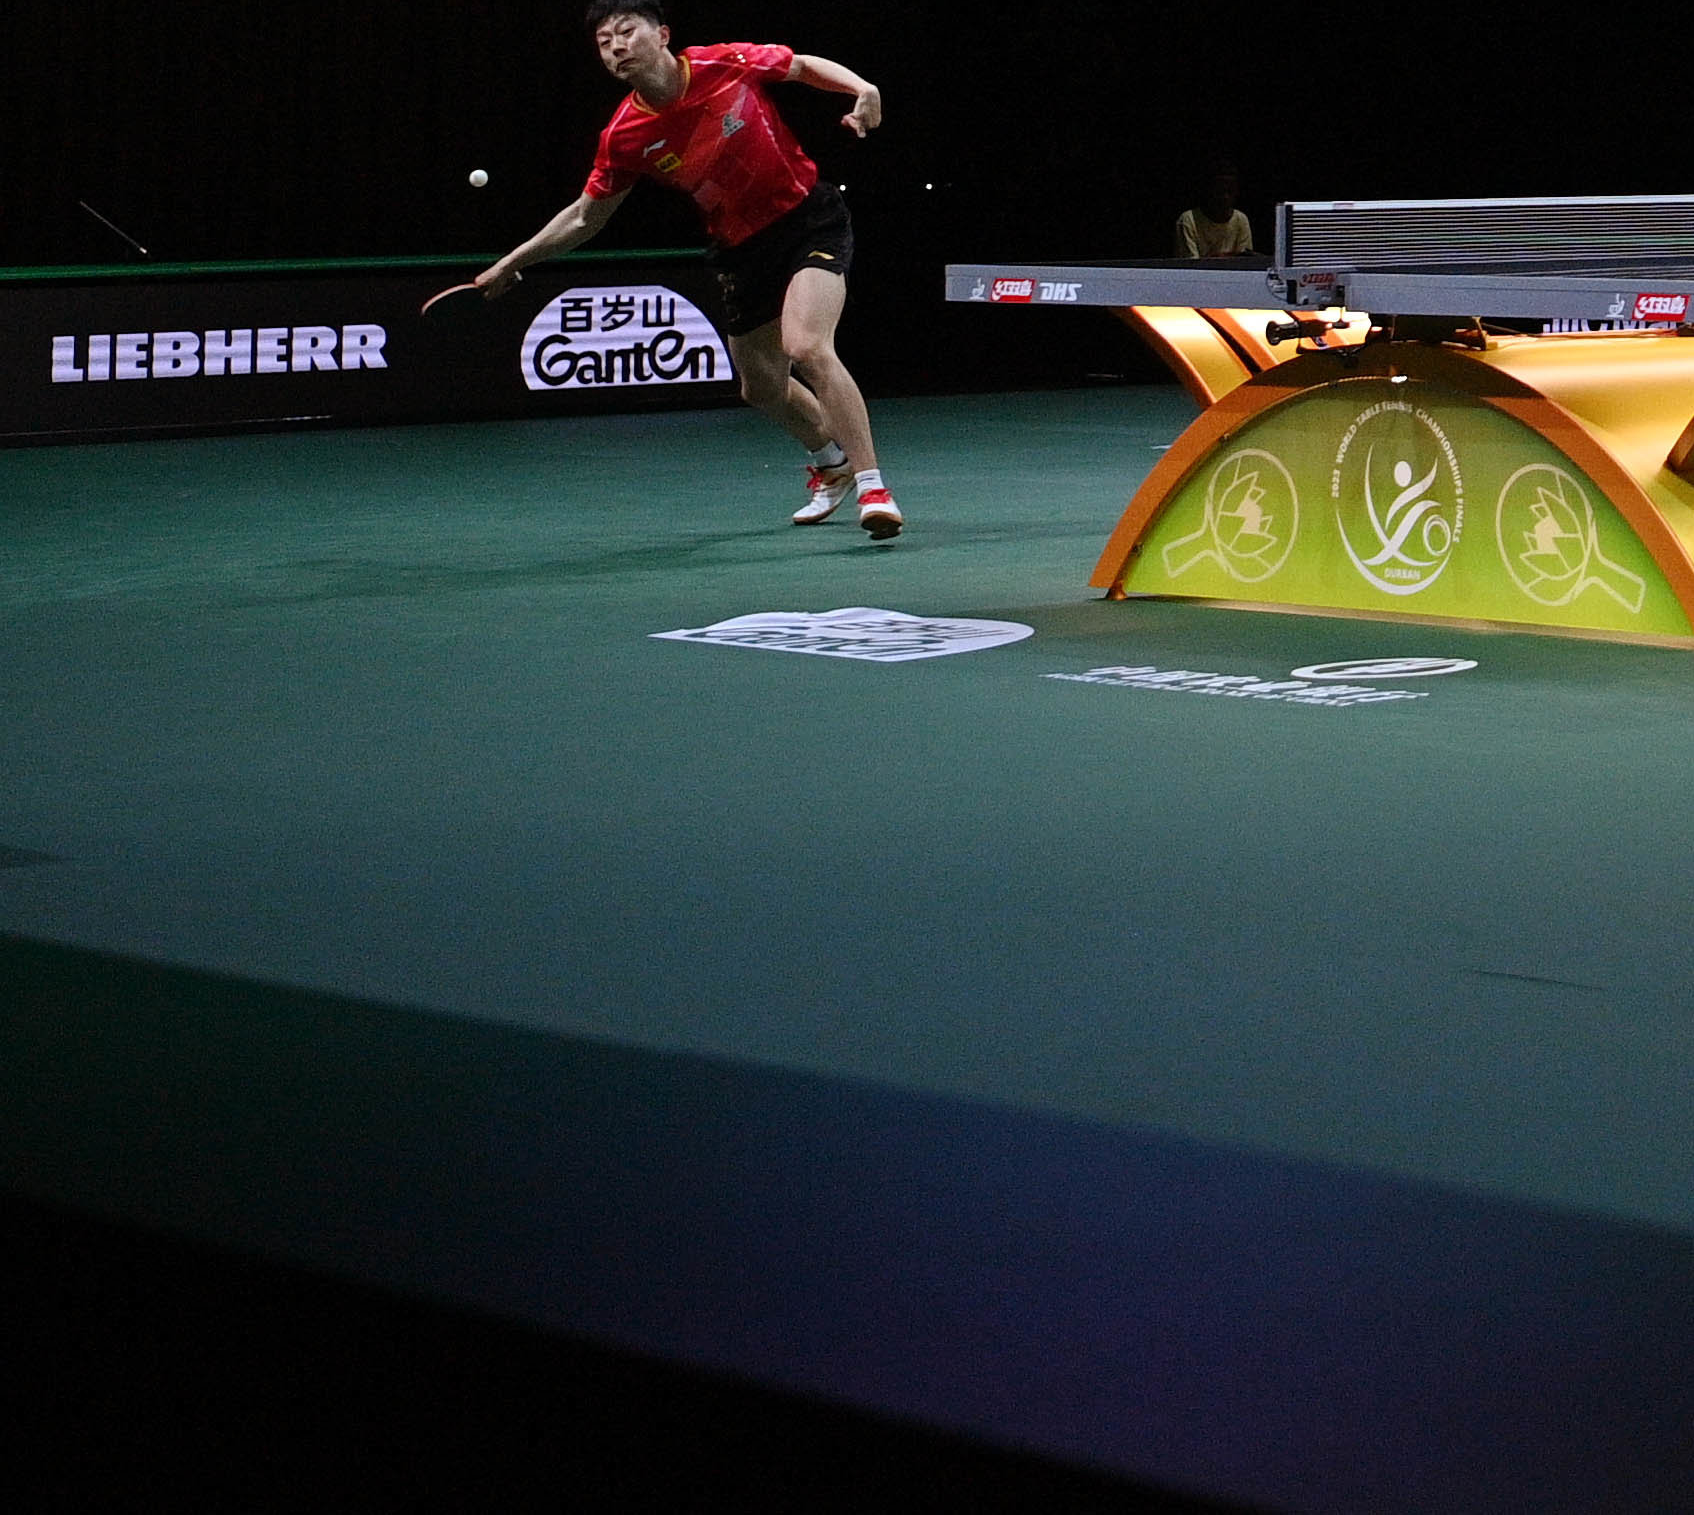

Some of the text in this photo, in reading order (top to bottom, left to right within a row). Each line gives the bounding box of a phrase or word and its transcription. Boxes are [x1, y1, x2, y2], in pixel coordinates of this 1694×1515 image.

[560, 294, 675, 333] 百岁山
[1039, 282, 1082, 301] DHS
[51, 324, 388, 383] LIEBHERR
[533, 329, 715, 385] Ganten
[1336, 425, 1357, 464] WORLD
[1356, 403, 1380, 425] TABLE
[1415, 408, 1464, 495] CHAMPIONSHIPS
